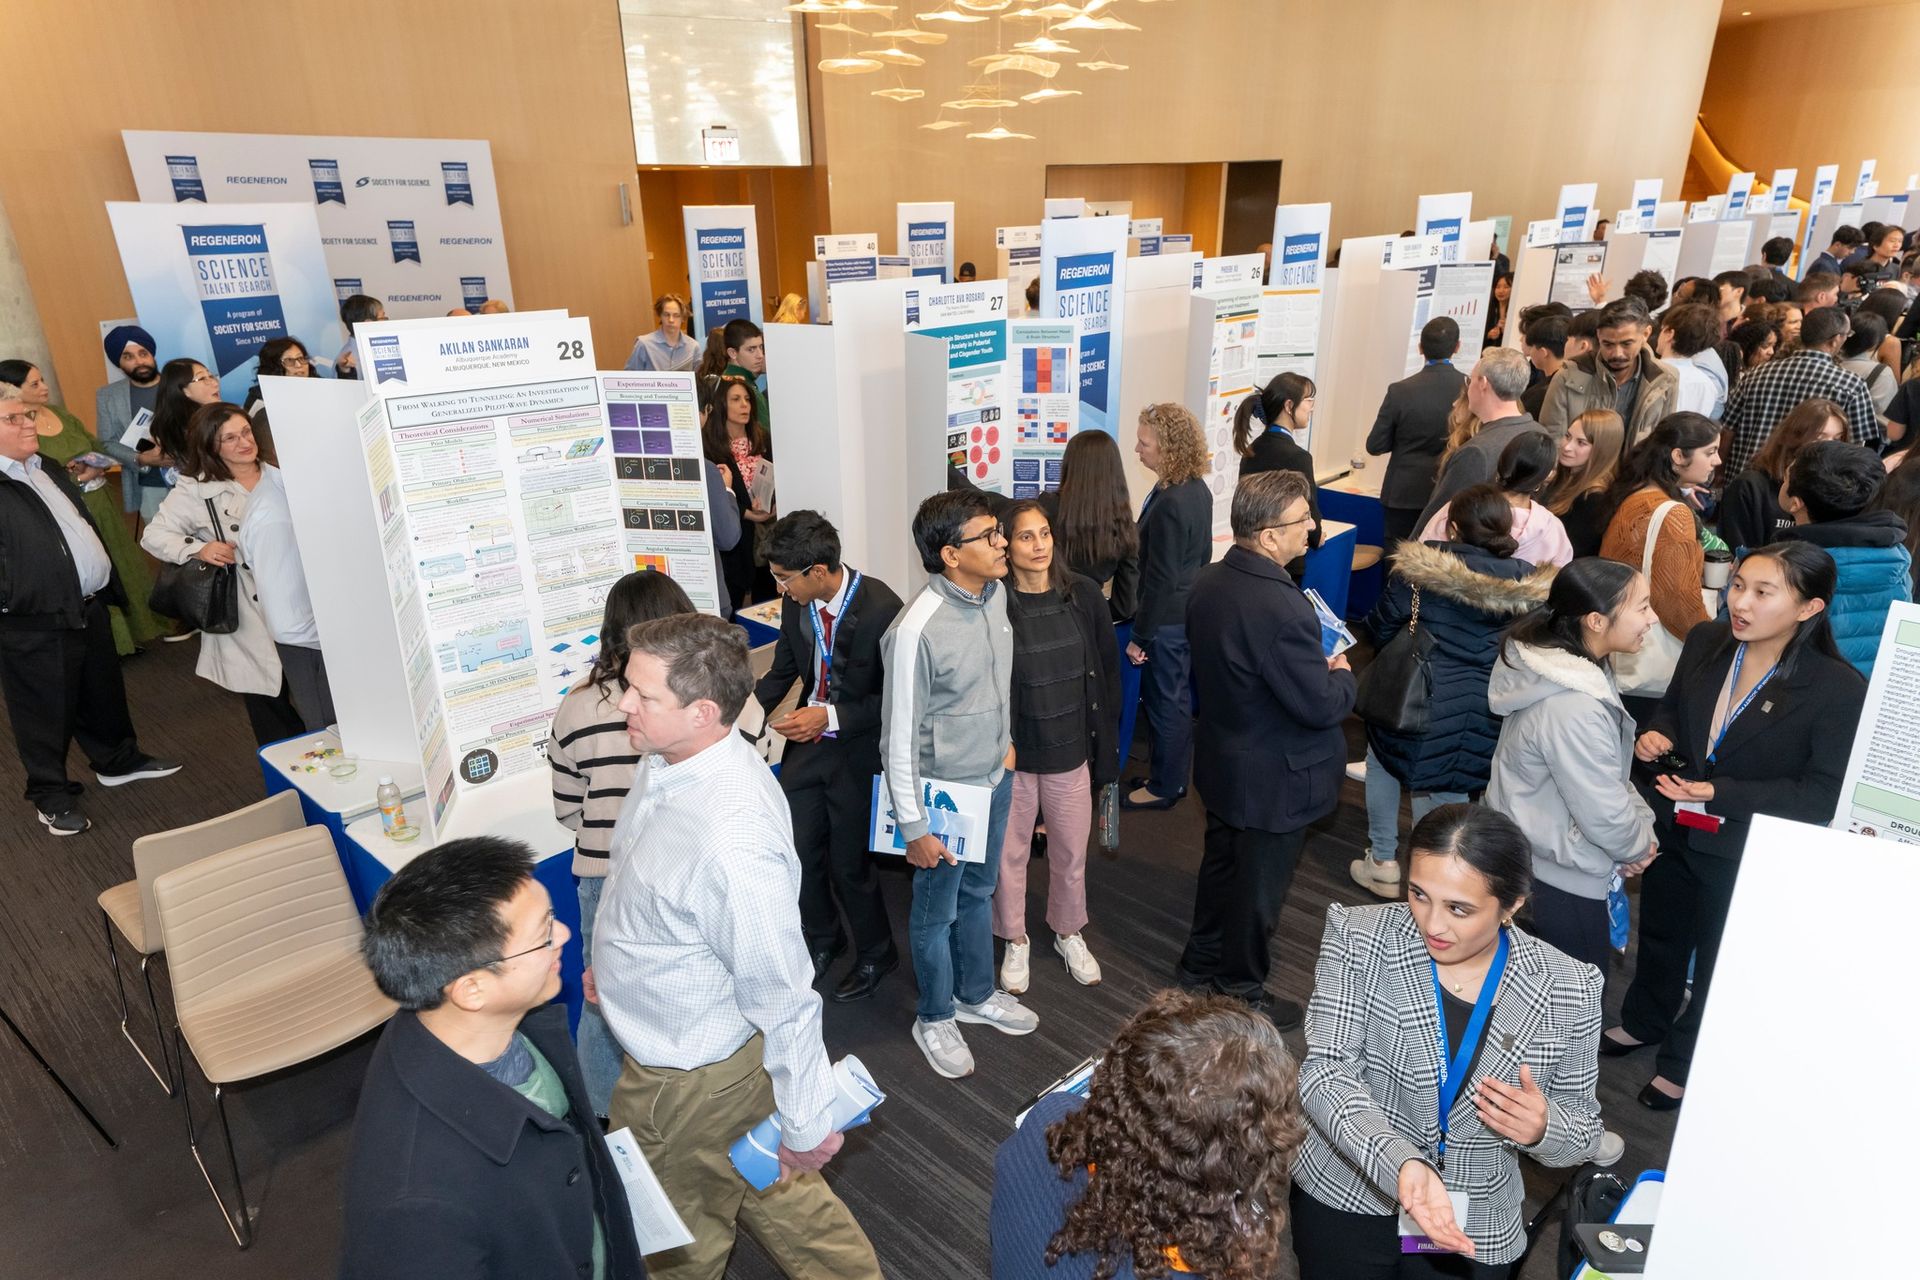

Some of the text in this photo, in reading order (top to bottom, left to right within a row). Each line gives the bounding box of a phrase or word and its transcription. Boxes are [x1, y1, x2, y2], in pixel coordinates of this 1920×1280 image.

[226, 176, 288, 184] REGENERON
[372, 178, 395, 186] SOCIETY
[911, 228, 944, 236] REGENERON
[191, 235, 261, 246] REGENERON
[700, 235, 742, 244] REGENERON
[867, 242, 875, 250] 40
[911, 243, 944, 257] SCIENCE
[1430, 245, 1438, 256] 25
[702, 252, 744, 268] SCIENCE
[198, 257, 269, 280] SCIENCE
[1060, 264, 1110, 280] REGENERON
[1251, 267, 1260, 279] 26
[1283, 264, 1316, 285] SCIENCE
[203, 280, 272, 295] TALENT SEARCH
[388, 294, 441, 302] REGENERON
[928, 292, 985, 306] CHARLOTTE AVA ROSARIO
[991, 296, 1003, 311] 27
[1059, 290, 1108, 318] SCIENCE
[232, 310, 255, 319] program
[214, 320, 281, 335] SOCIETY FOR SCIENCE
[1084, 316, 1108, 330] SEARCH
[236, 336, 266, 346] Since 1942
[954, 333, 974, 341] Structure
[440, 337, 529, 356] AKILAN SANKARAN
[557, 340, 584, 361] 28
[951, 342, 967, 350] Anxiety
[973, 339, 990, 347] Pubertal
[959, 349, 980, 358] Cisgender
[1087, 360, 1106, 372] SCIENCE
[1082, 378, 1093, 387] 1942
[520, 412, 590, 424] Numerical Simulations
[399, 424, 489, 440] Theoretical Considerations
[1418, 1242, 1439, 1250] FINALI
